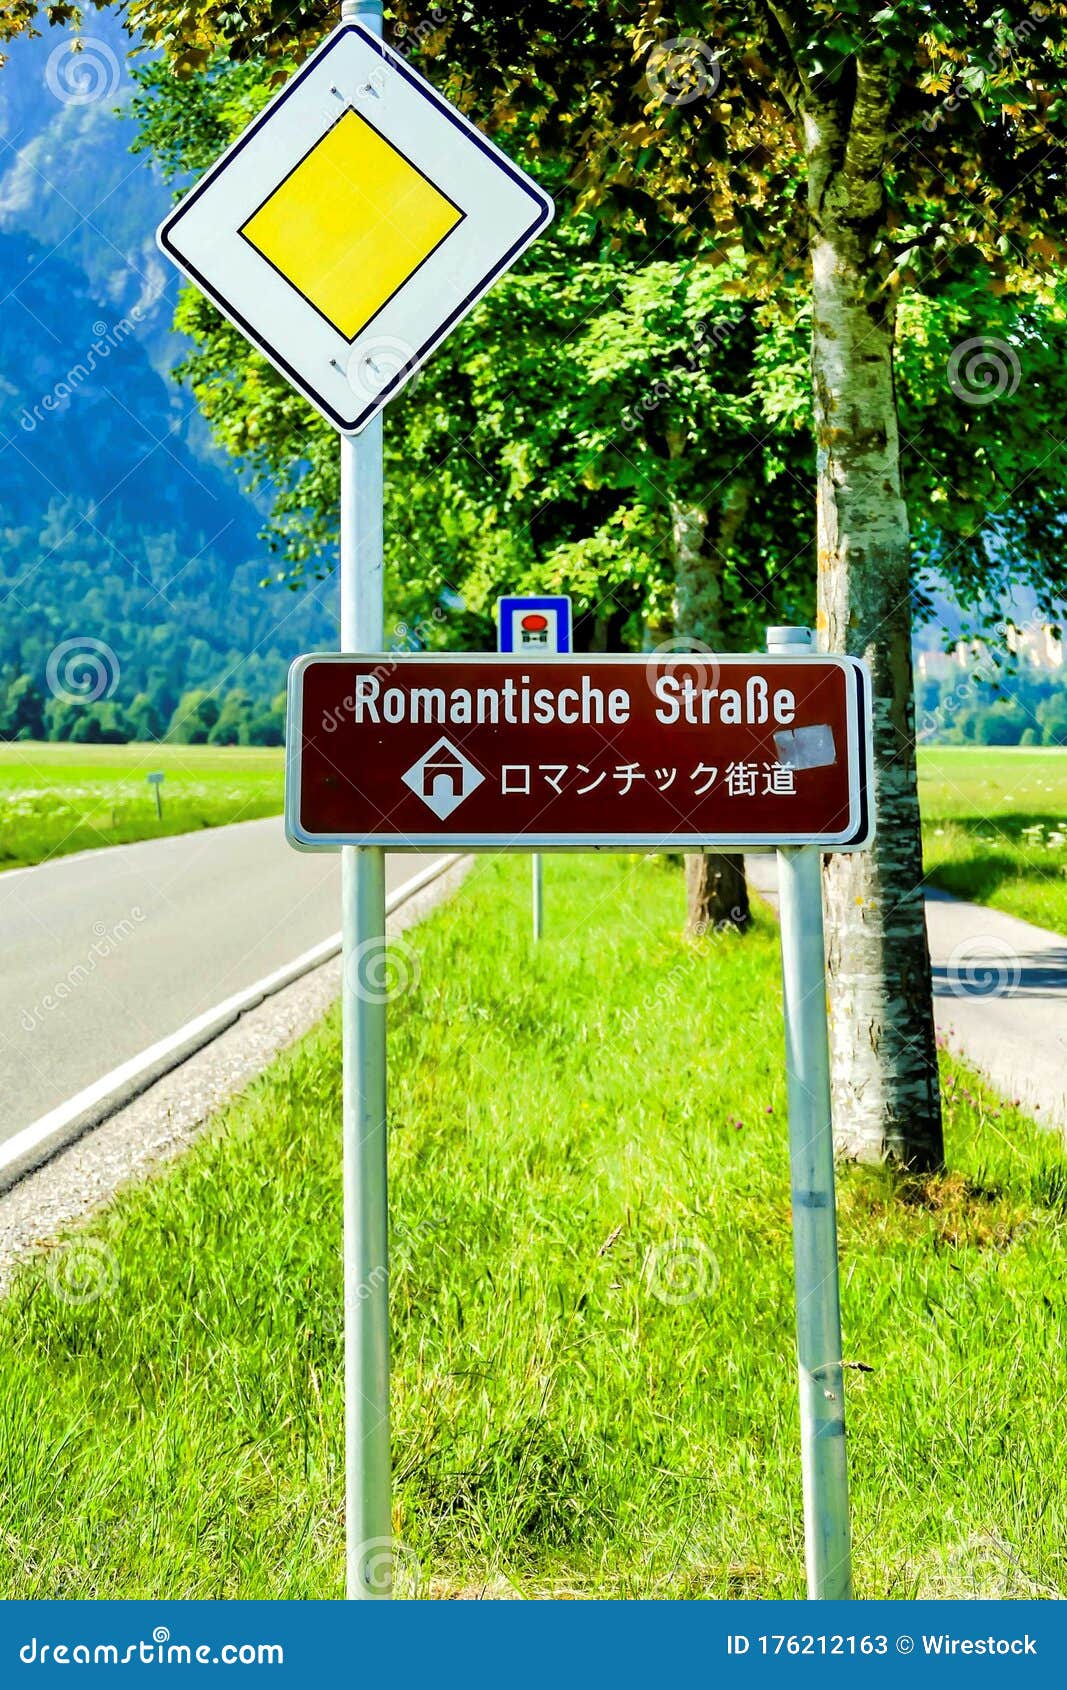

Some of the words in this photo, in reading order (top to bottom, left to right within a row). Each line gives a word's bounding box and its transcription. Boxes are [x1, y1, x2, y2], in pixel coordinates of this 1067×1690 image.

[355, 675, 630, 724] Romantische
[655, 675, 796, 725] Straße
[500, 760, 798, 797] ロマンチック街道
